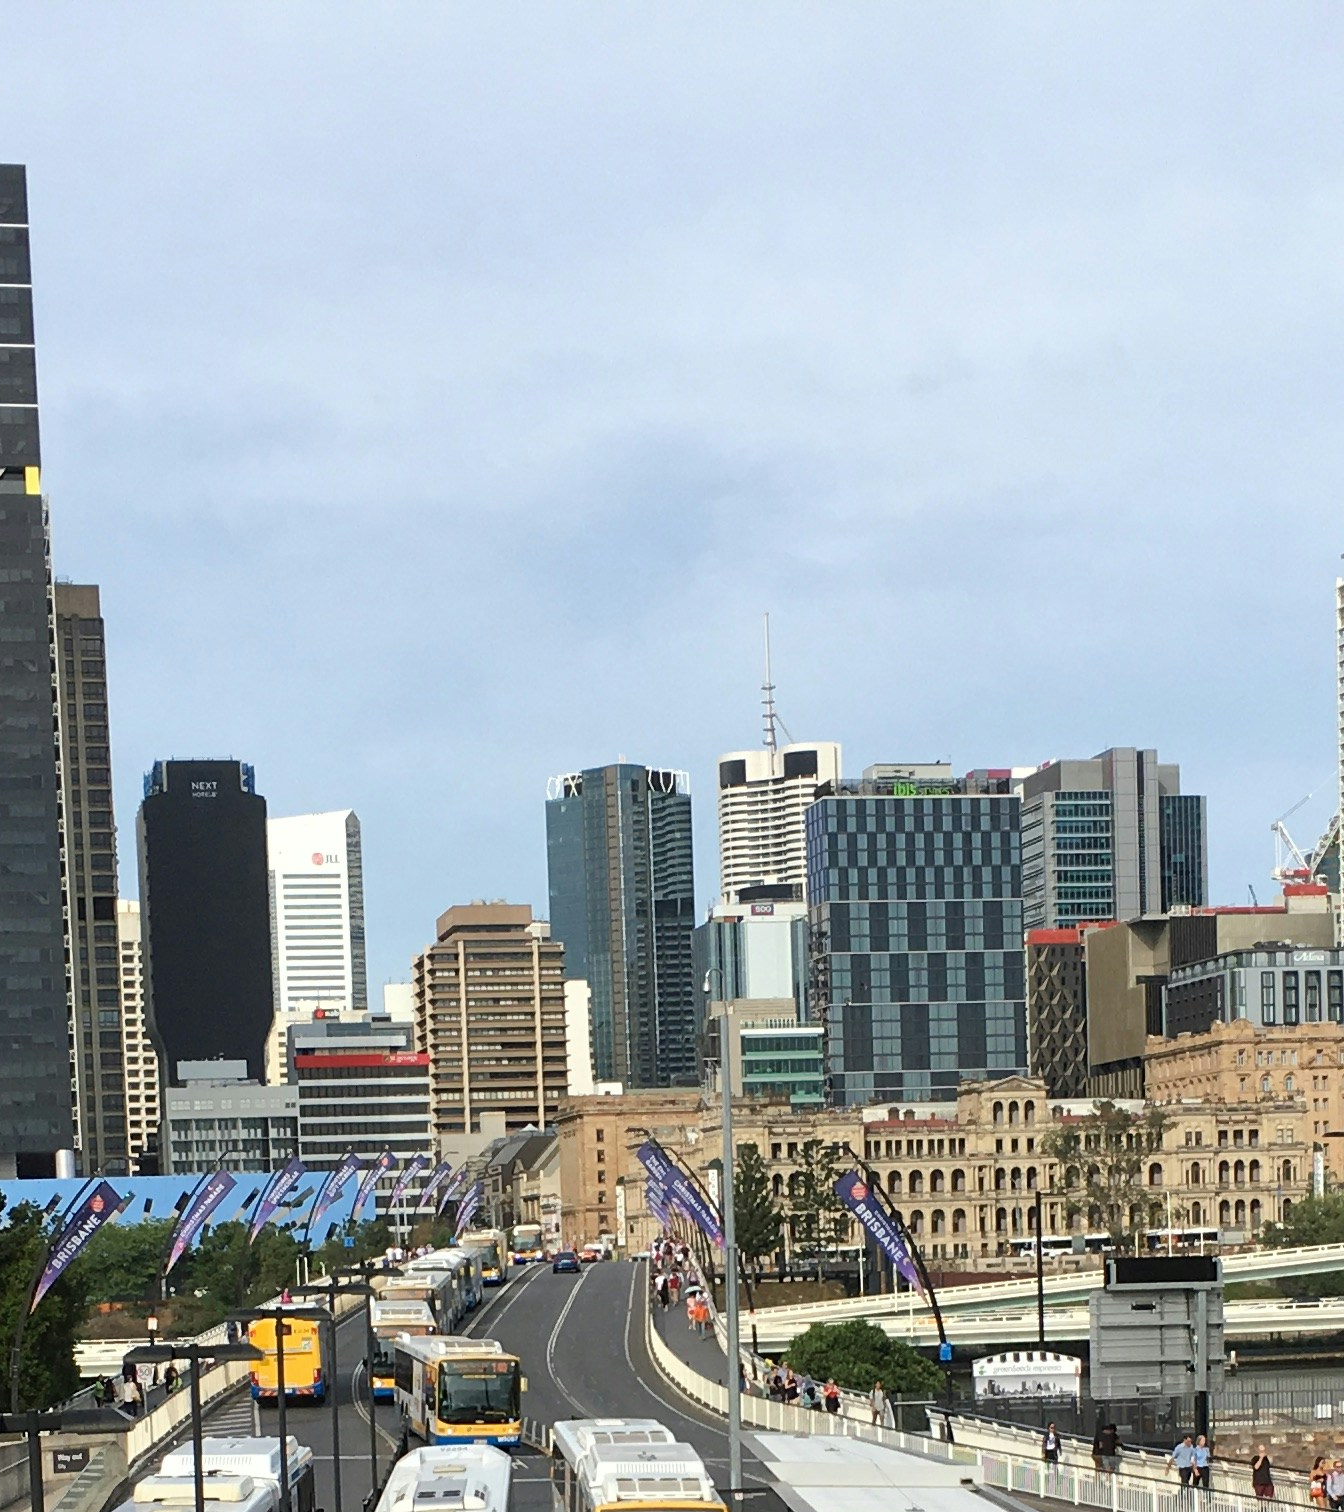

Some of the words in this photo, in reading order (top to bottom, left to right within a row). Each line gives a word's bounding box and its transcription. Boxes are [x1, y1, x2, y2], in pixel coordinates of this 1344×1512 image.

[191, 781, 218, 790] NEXT
[325, 855, 340, 864] JLL
[673, 1179, 702, 1212] CHRISTMAS
[51, 1213, 102, 1270] BRISBANE
[854, 1202, 904, 1262] BRISBANE
